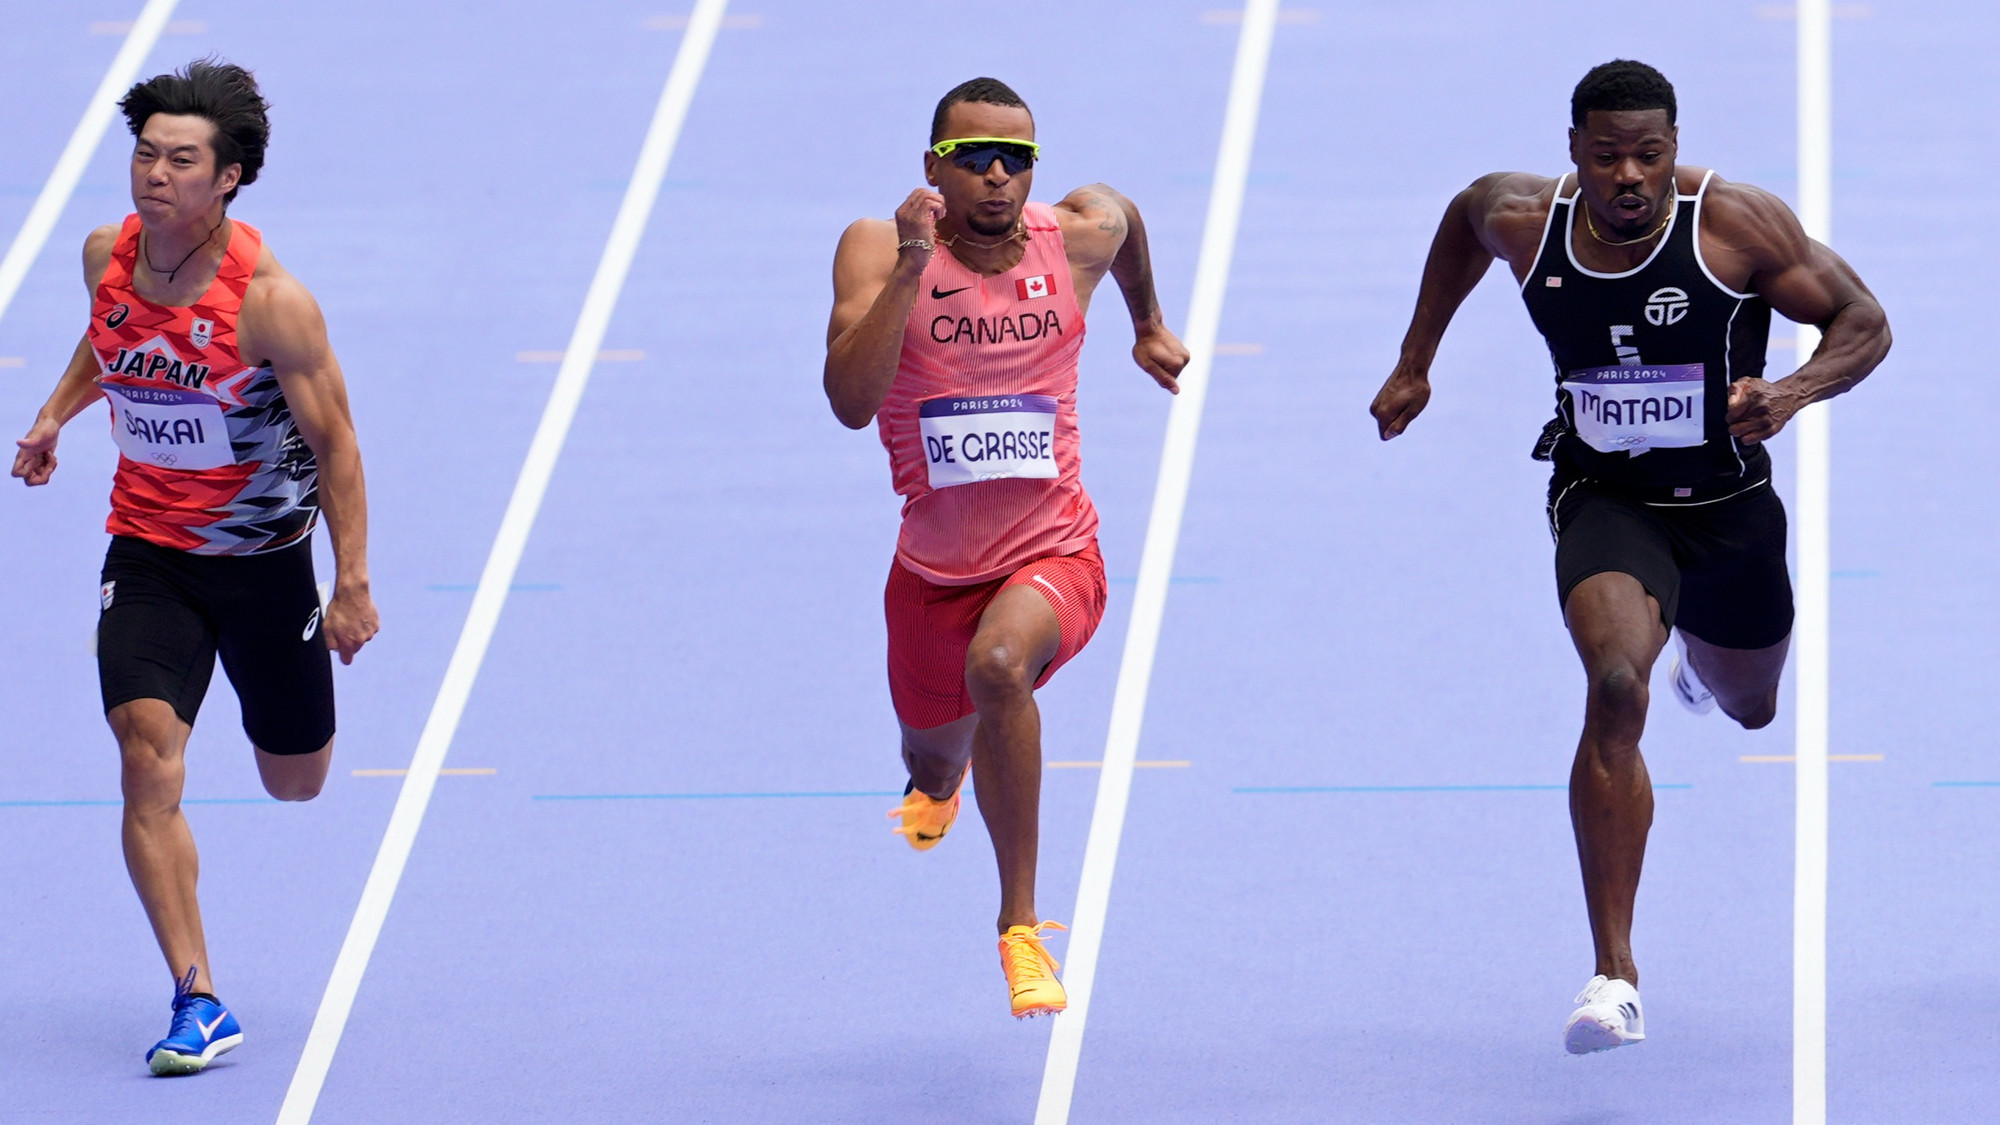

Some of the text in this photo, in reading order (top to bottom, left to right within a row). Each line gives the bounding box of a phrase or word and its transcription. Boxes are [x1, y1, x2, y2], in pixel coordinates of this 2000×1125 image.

[931, 310, 1062, 344] CANADA
[108, 348, 211, 389] JAPAN
[1597, 370, 1667, 380] PARIS 2024
[120, 388, 183, 402] PARIS 2024
[953, 398, 1023, 411] PARIS 2024
[1581, 389, 1693, 426] MATADI
[124, 408, 205, 445] SAKAI
[926, 430, 1051, 464] DE GRASSE
